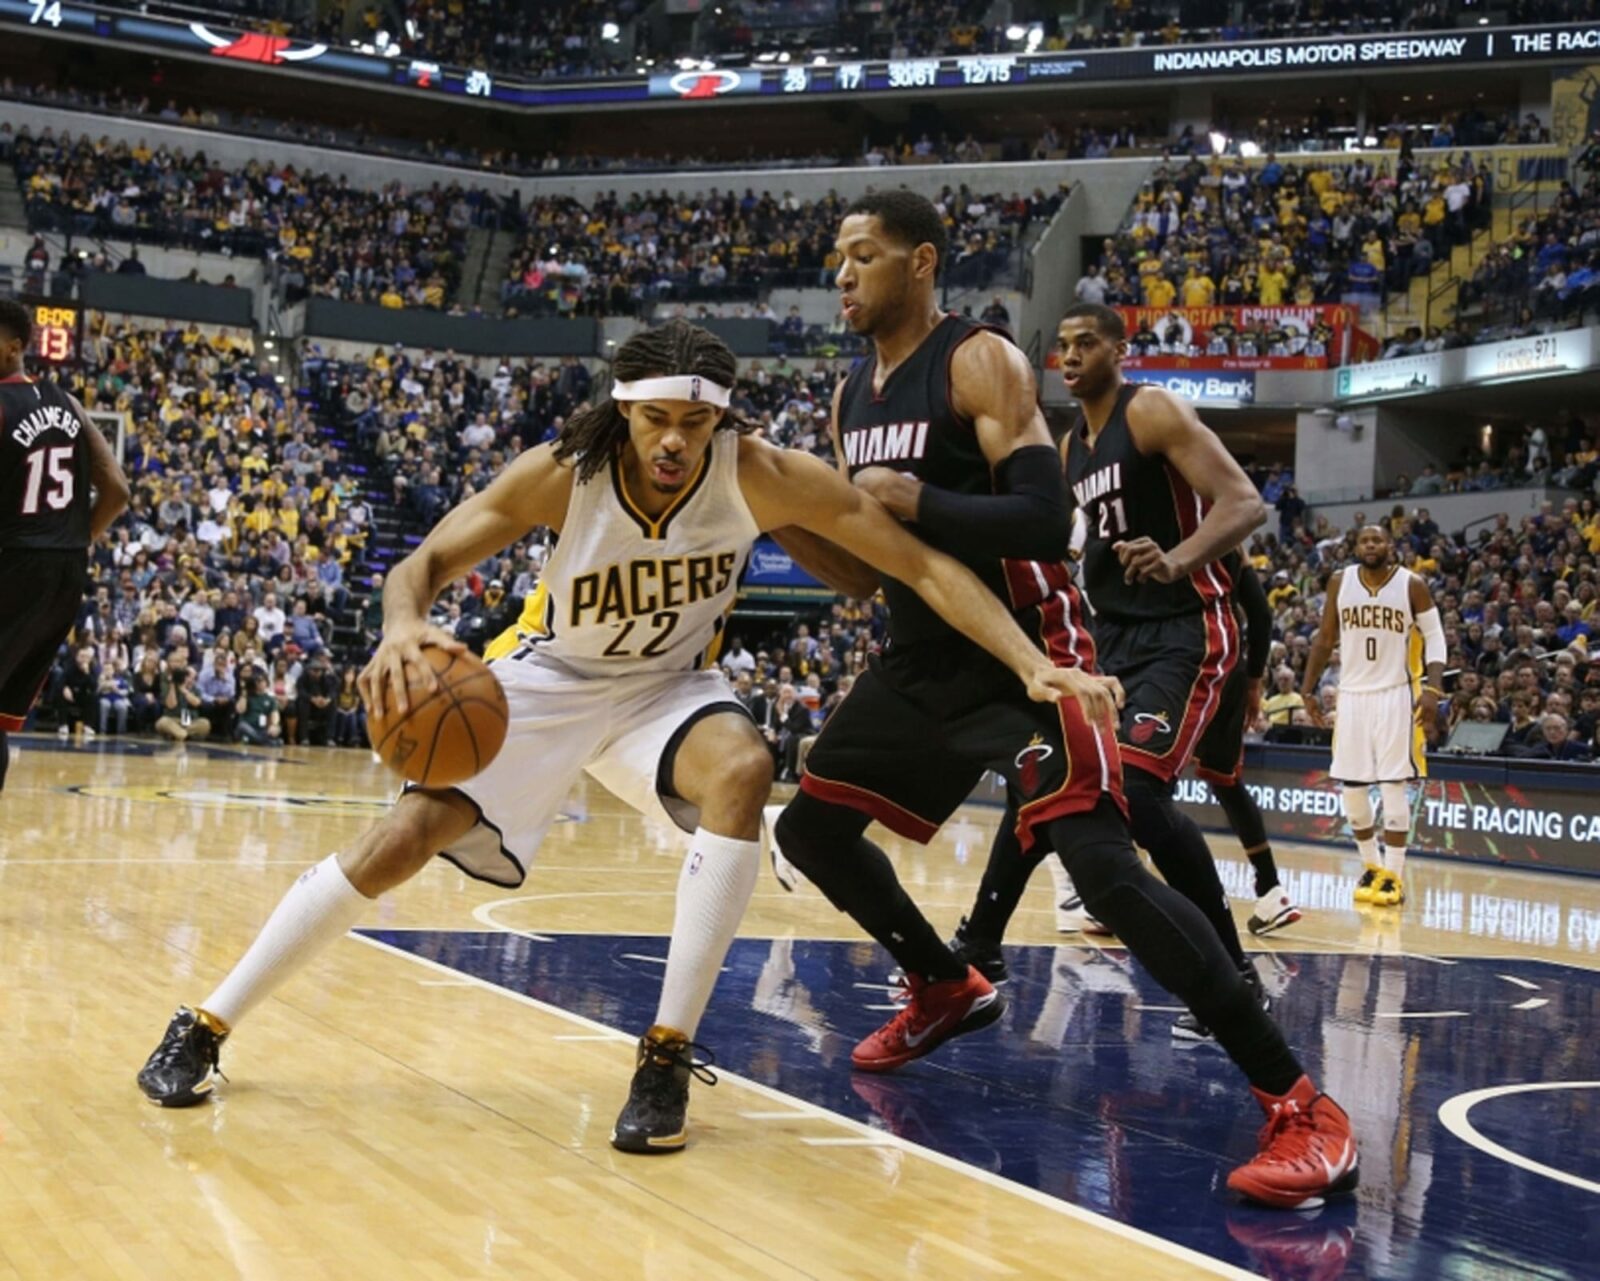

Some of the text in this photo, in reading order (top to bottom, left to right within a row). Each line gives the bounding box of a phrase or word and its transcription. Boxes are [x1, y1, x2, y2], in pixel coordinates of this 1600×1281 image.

[28, 0, 62, 28] 74
[1153, 37, 1467, 71] INDIANAPOLIS MOTOR SPEEDWAY
[1511, 33, 1551, 52] THE
[36, 306, 76, 328] 8:09
[41, 327, 68, 361] 13
[1166, 378, 1204, 400] City
[1205, 378, 1252, 396] Bank
[12, 405, 80, 448] CHALMERS
[22, 446, 75, 514] 15
[1099, 498, 1128, 539] 21
[570, 552, 737, 628] PACERS
[602, 610, 680, 657] 22
[1342, 605, 1404, 633] PACERS
[1366, 636, 1377, 661] 0
[1424, 800, 1466, 830] THE
[1473, 804, 1563, 839] RACING
